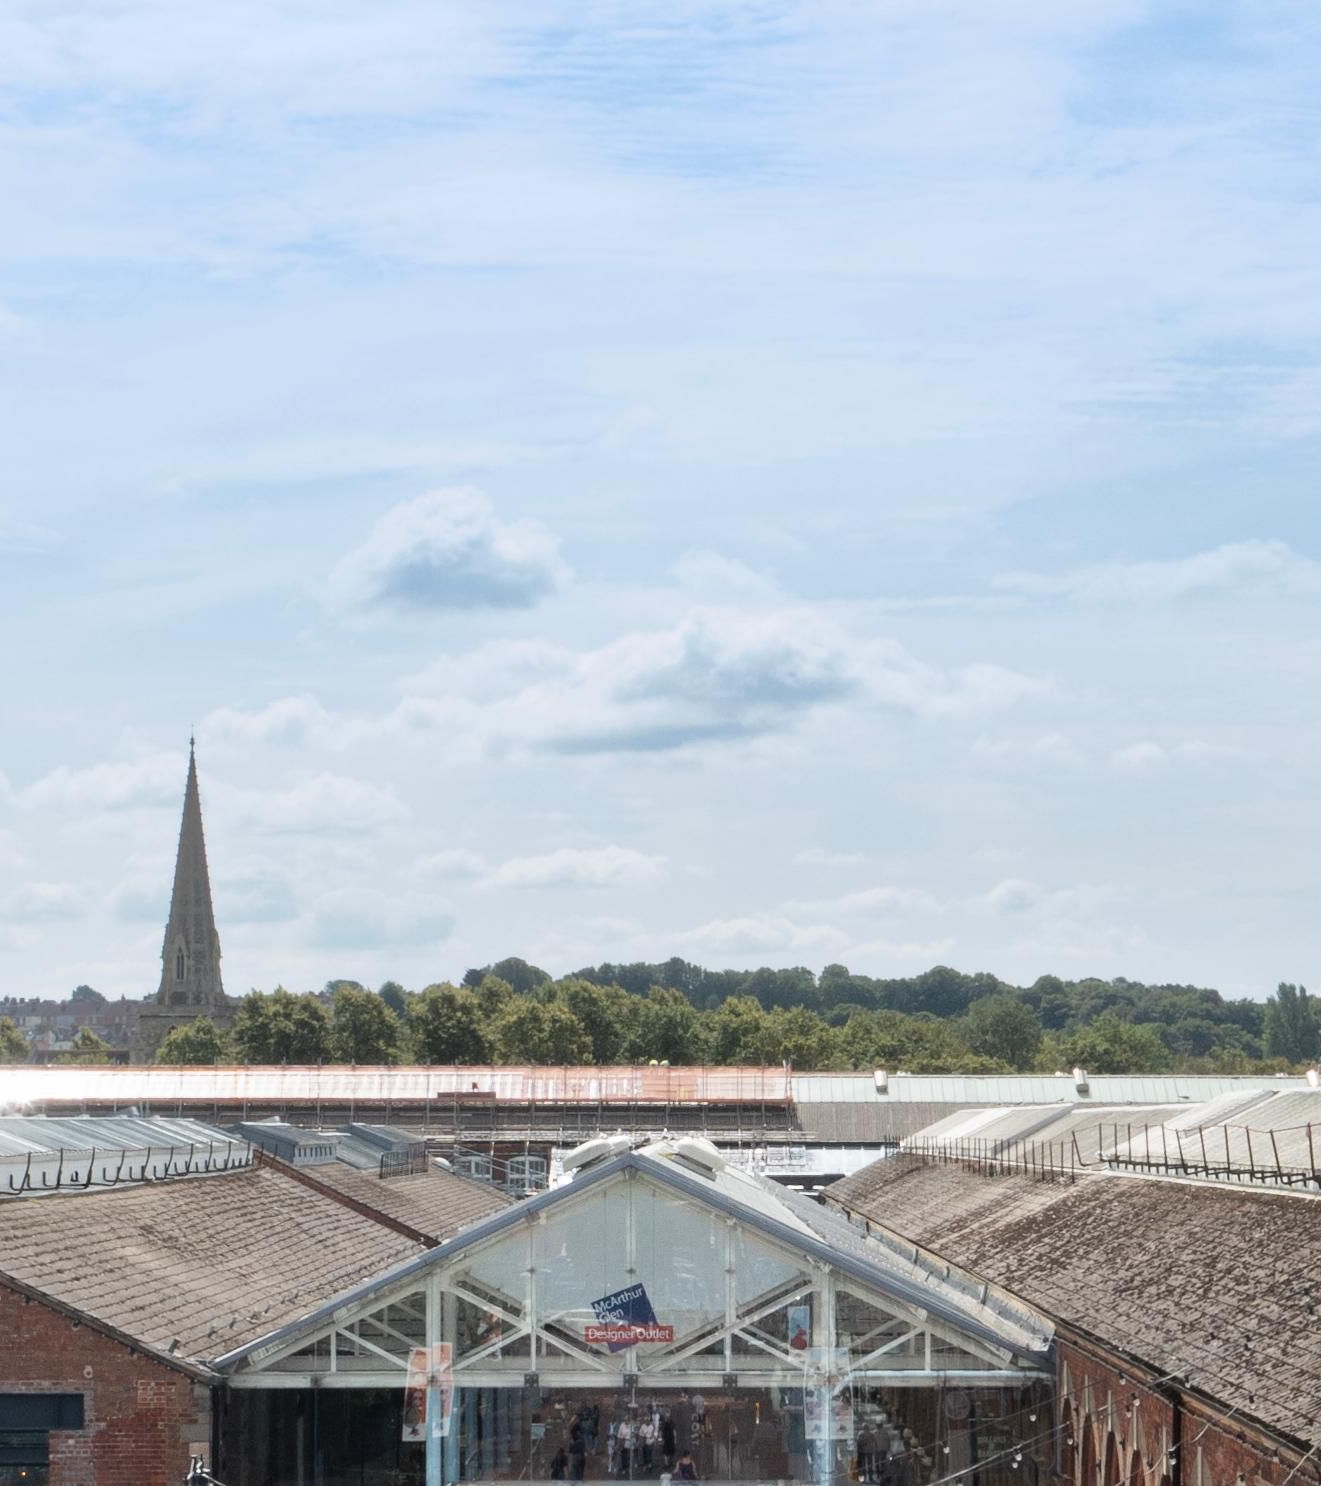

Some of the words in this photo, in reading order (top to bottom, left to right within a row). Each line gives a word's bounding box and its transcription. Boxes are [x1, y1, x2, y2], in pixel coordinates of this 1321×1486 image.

[594, 1287, 643, 1313] McArthur
[599, 1308, 625, 1324] Glen
[589, 1328, 635, 1342] Designer
[636, 1328, 670, 1340] Outlet
